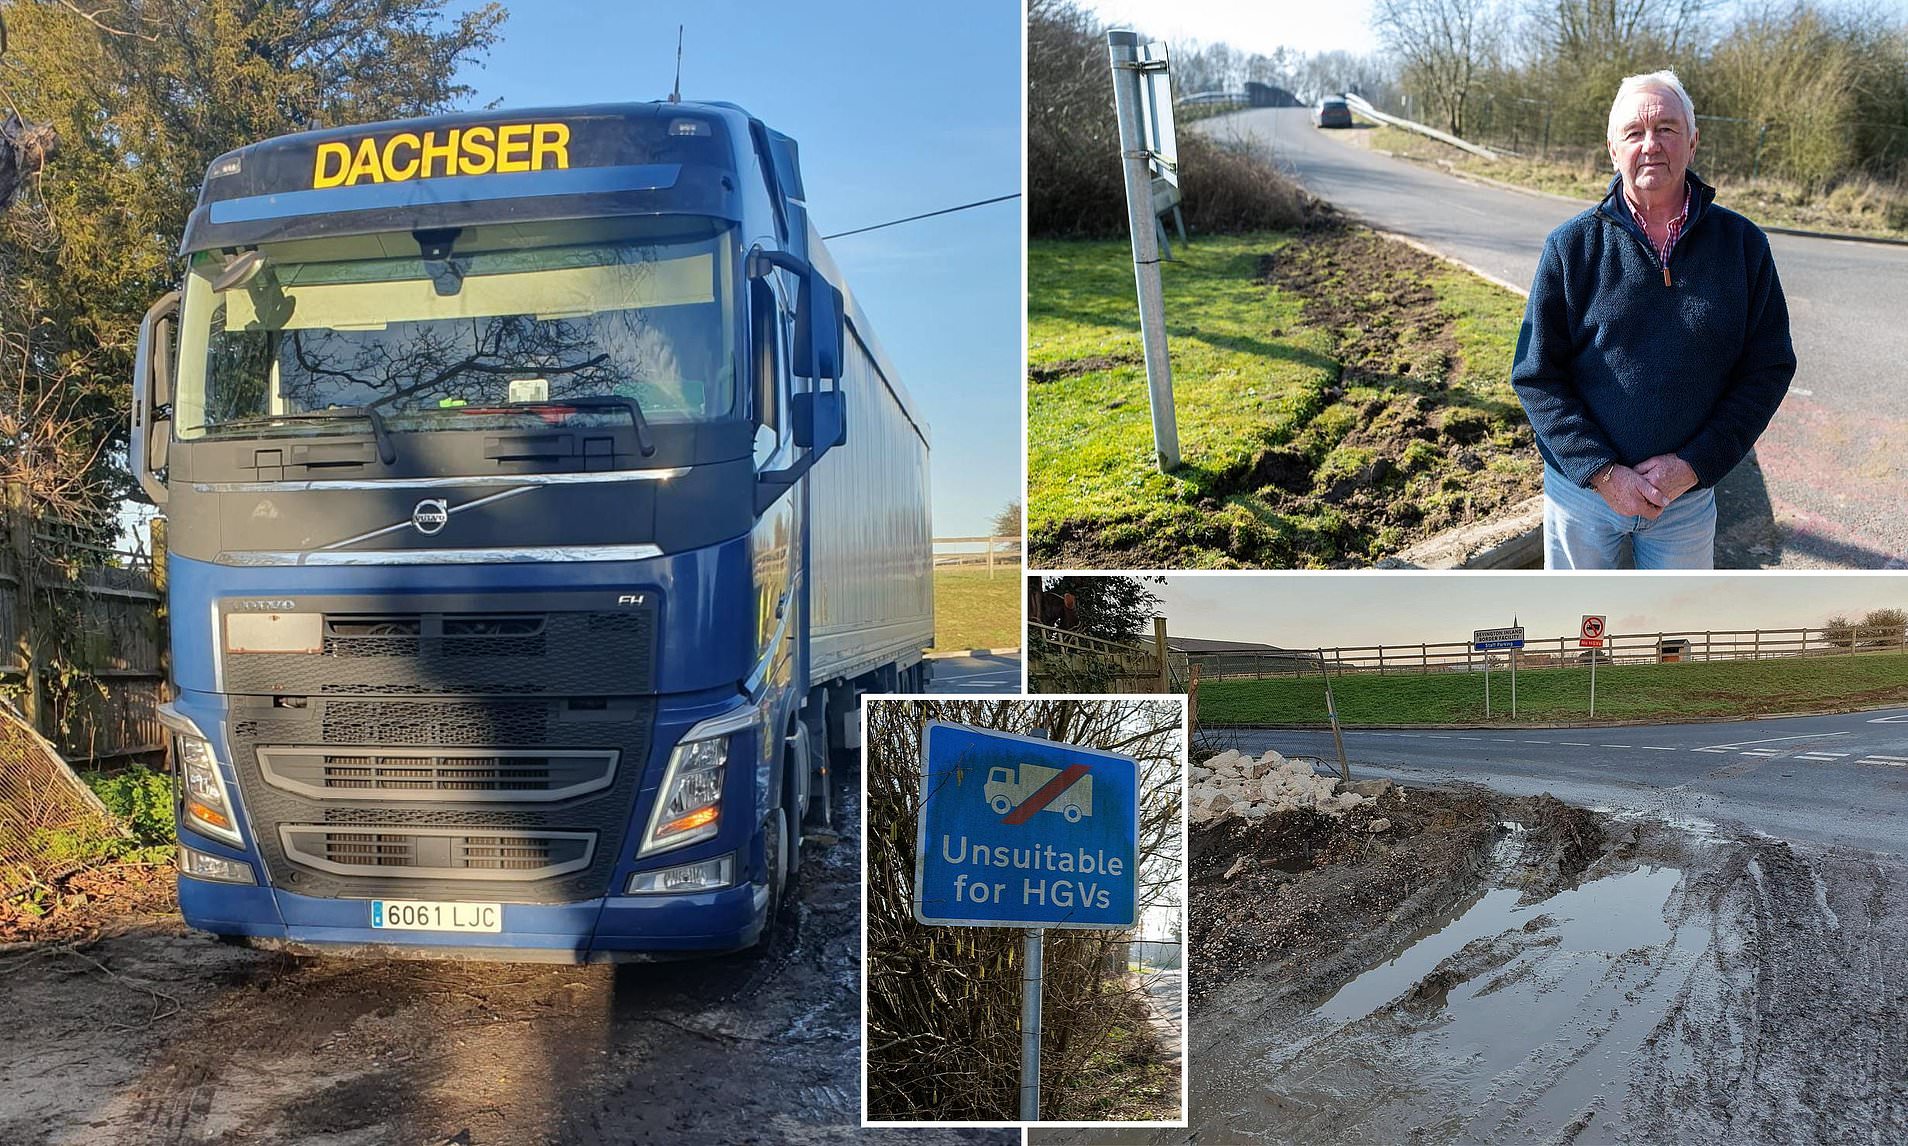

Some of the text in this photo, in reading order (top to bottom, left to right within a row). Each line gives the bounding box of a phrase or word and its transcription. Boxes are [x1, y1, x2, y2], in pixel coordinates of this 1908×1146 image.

[313, 122, 571, 189] DACHSER
[415, 514, 446, 522] VOLVO
[618, 595, 644, 604] FH
[942, 834, 1124, 876] Unsuitable
[953, 874, 1110, 909] for HGVs
[388, 905, 494, 928] 6061 LJC
